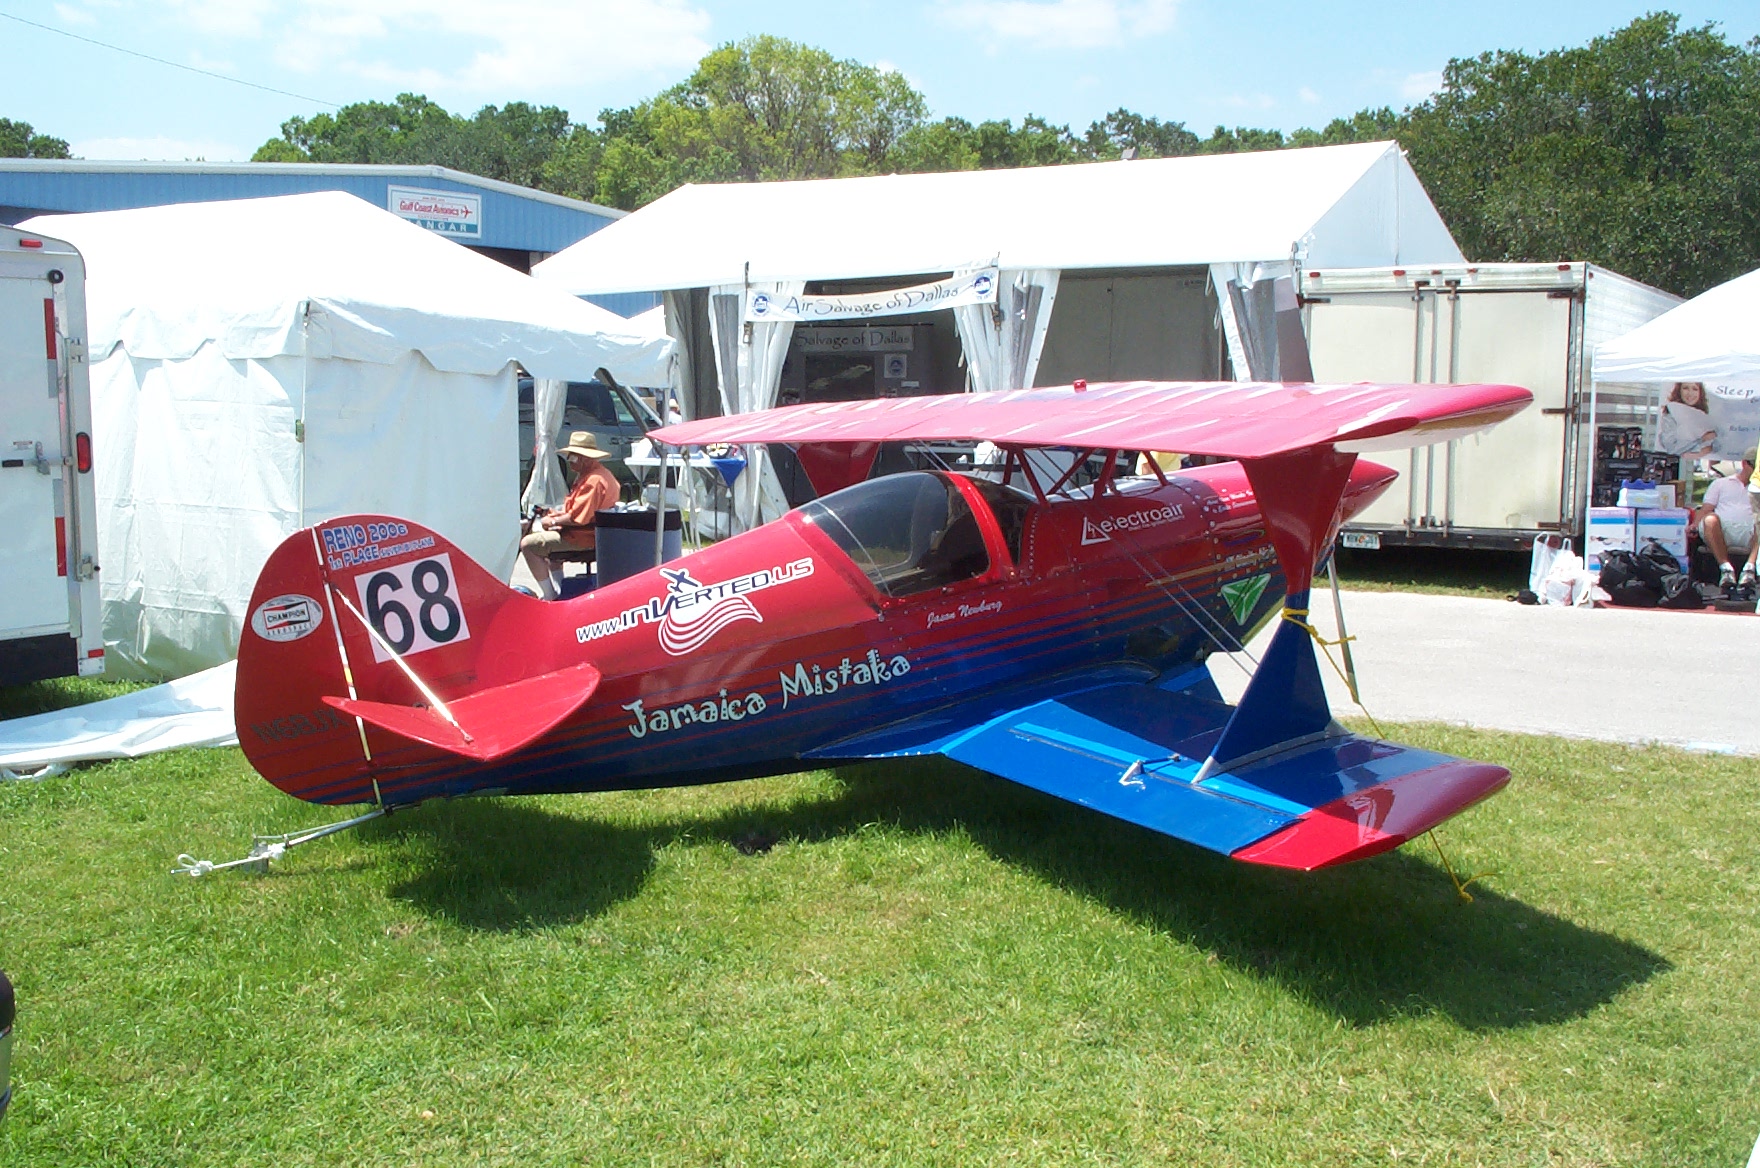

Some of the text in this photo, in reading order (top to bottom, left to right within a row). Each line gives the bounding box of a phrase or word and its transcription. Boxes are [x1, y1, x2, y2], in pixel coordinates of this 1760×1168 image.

[400, 200, 459, 216] Gulf Coast Avionics
[409, 219, 467, 232] ANGAR
[783, 296, 813, 314] Air
[814, 298, 882, 316] Salvage
[886, 293, 902, 309] of
[902, 284, 959, 308] Dallas
[795, 328, 909, 350] Salvage of Dallas
[1715, 385, 1754, 398] Sleep
[1100, 502, 1183, 532] electroair
[322, 522, 408, 554] RENO 2006
[342, 544, 380, 567] PLACE
[267, 609, 306, 623] CHAMPION
[366, 559, 461, 655] 68
[622, 649, 912, 739] Jamaica Mistaka
